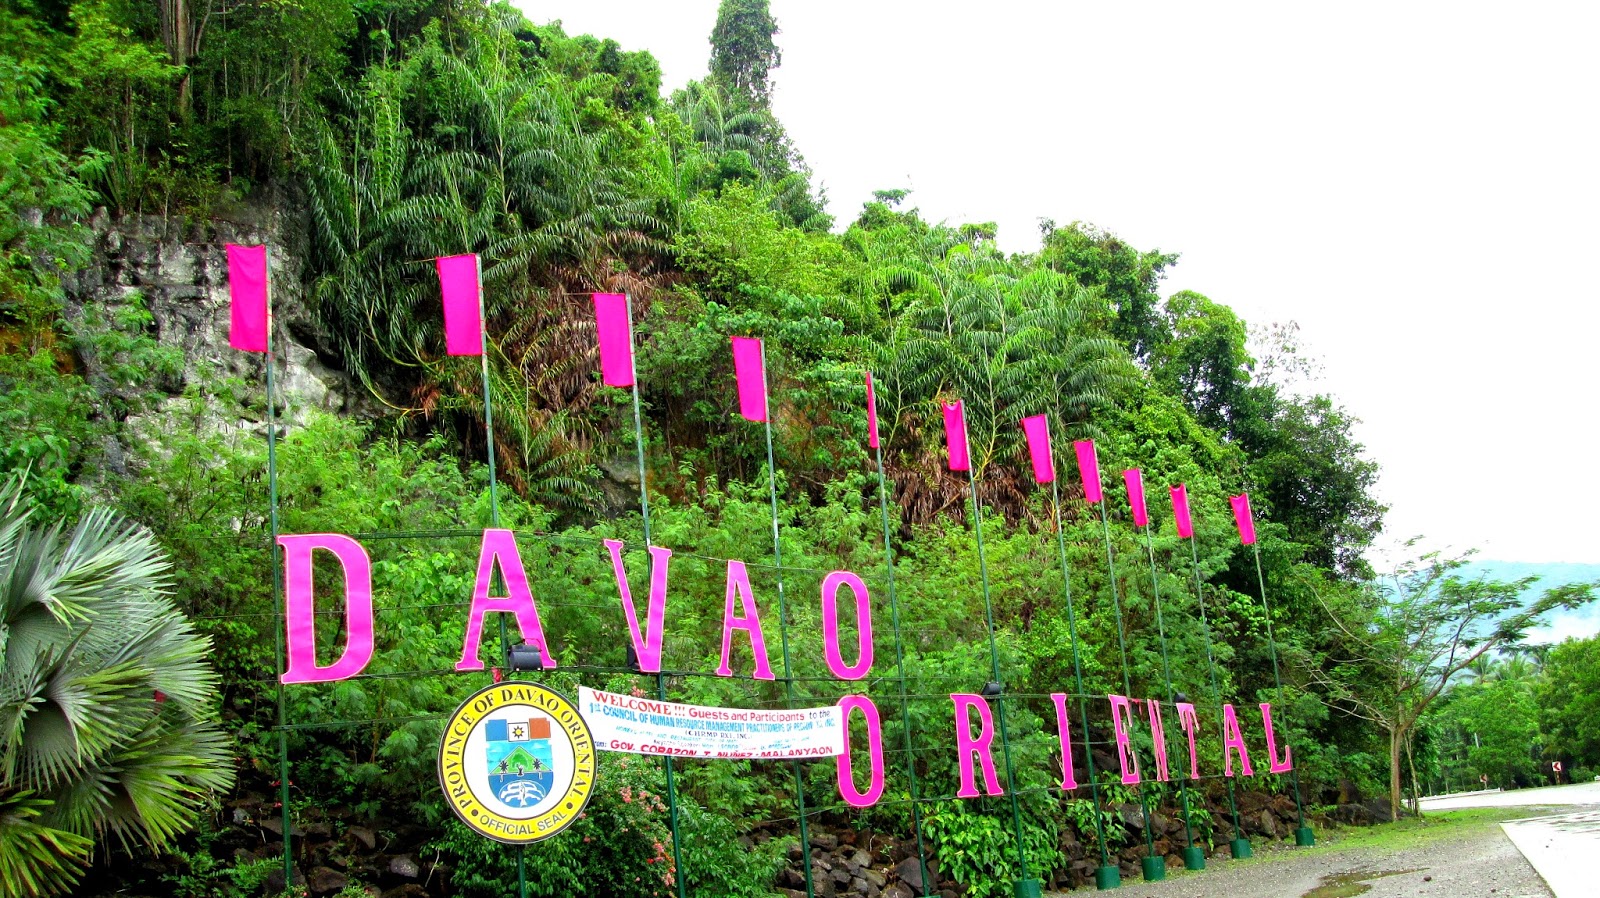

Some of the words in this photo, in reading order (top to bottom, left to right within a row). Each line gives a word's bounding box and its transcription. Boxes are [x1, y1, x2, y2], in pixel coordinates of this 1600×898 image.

[276, 528, 874, 685] DAVAO
[592, 690, 671, 715] WELCOME
[688, 707, 730, 720] Guests
[731, 712, 748, 722] and
[750, 712, 805, 723] Participants
[809, 711, 817, 719] to
[819, 709, 831, 719] the
[603, 705, 638, 722] COUNCIL
[639, 713, 649, 724] OF
[649, 714, 675, 728] HUMAN
[675, 717, 705, 731] RESOURCE
[705, 720, 745, 732] MANAGEMENT
[446, 712, 475, 810] PROVINCE
[474, 692, 495, 714] OF
[501, 688, 560, 712] DAVAO
[560, 710, 591, 799] ORIENTAL
[640, 744, 697, 756] CORAZON
[836, 693, 1293, 808] ORIENTAL
[480, 814, 536, 835] OFFICIAL
[538, 810, 569, 832] SEAL
